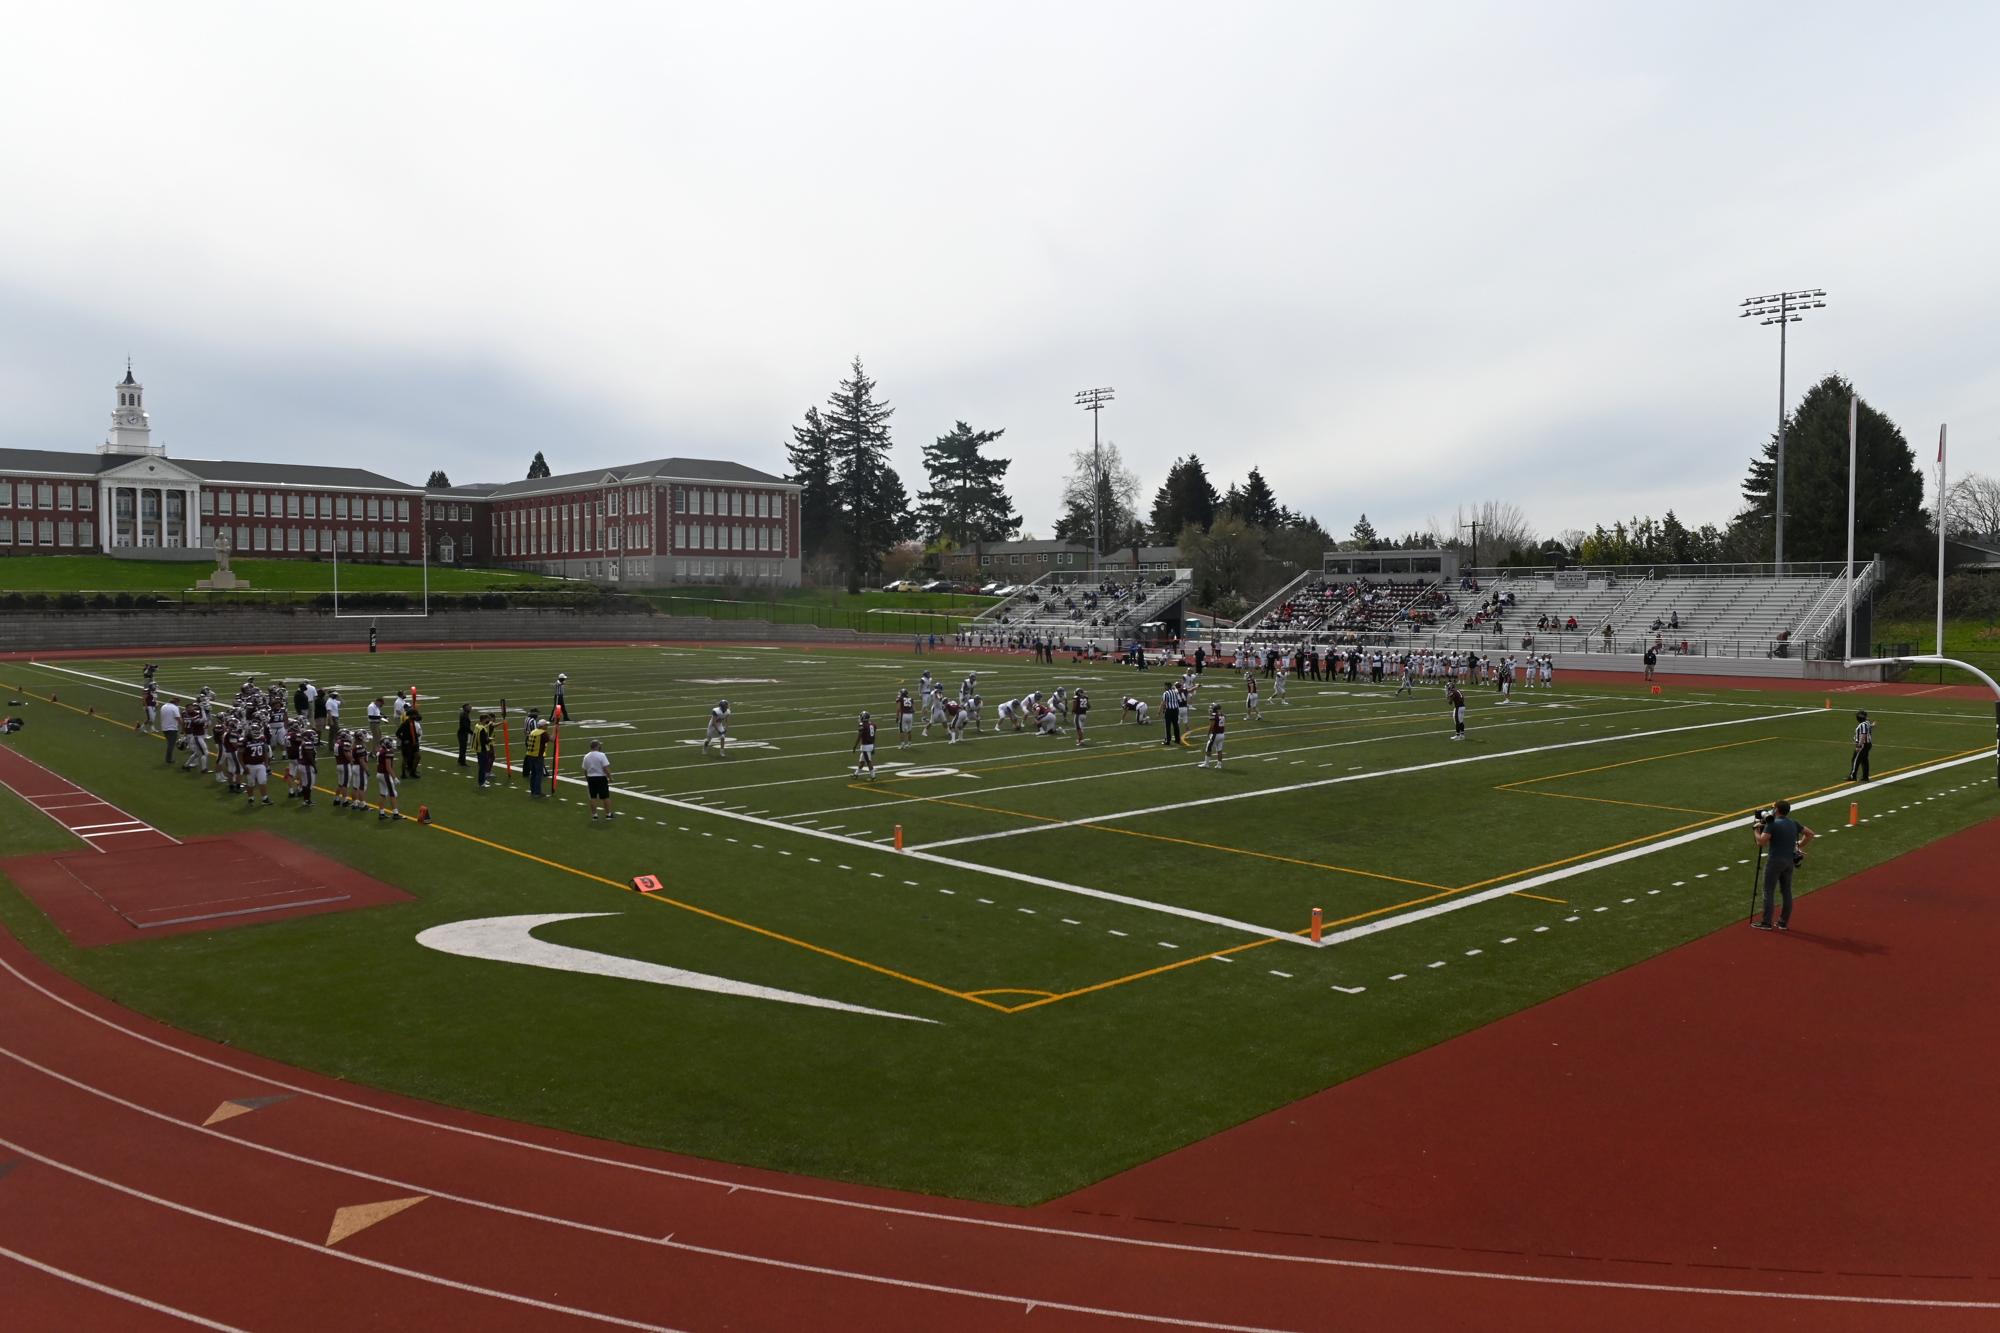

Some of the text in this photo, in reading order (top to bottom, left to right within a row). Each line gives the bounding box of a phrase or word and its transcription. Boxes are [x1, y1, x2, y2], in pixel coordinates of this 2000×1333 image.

[903, 697, 912, 707] 25
[1079, 697, 1088, 708] 22
[869, 724, 875, 737] 8
[250, 745, 263, 757] 70
[641, 877, 655, 889] G
